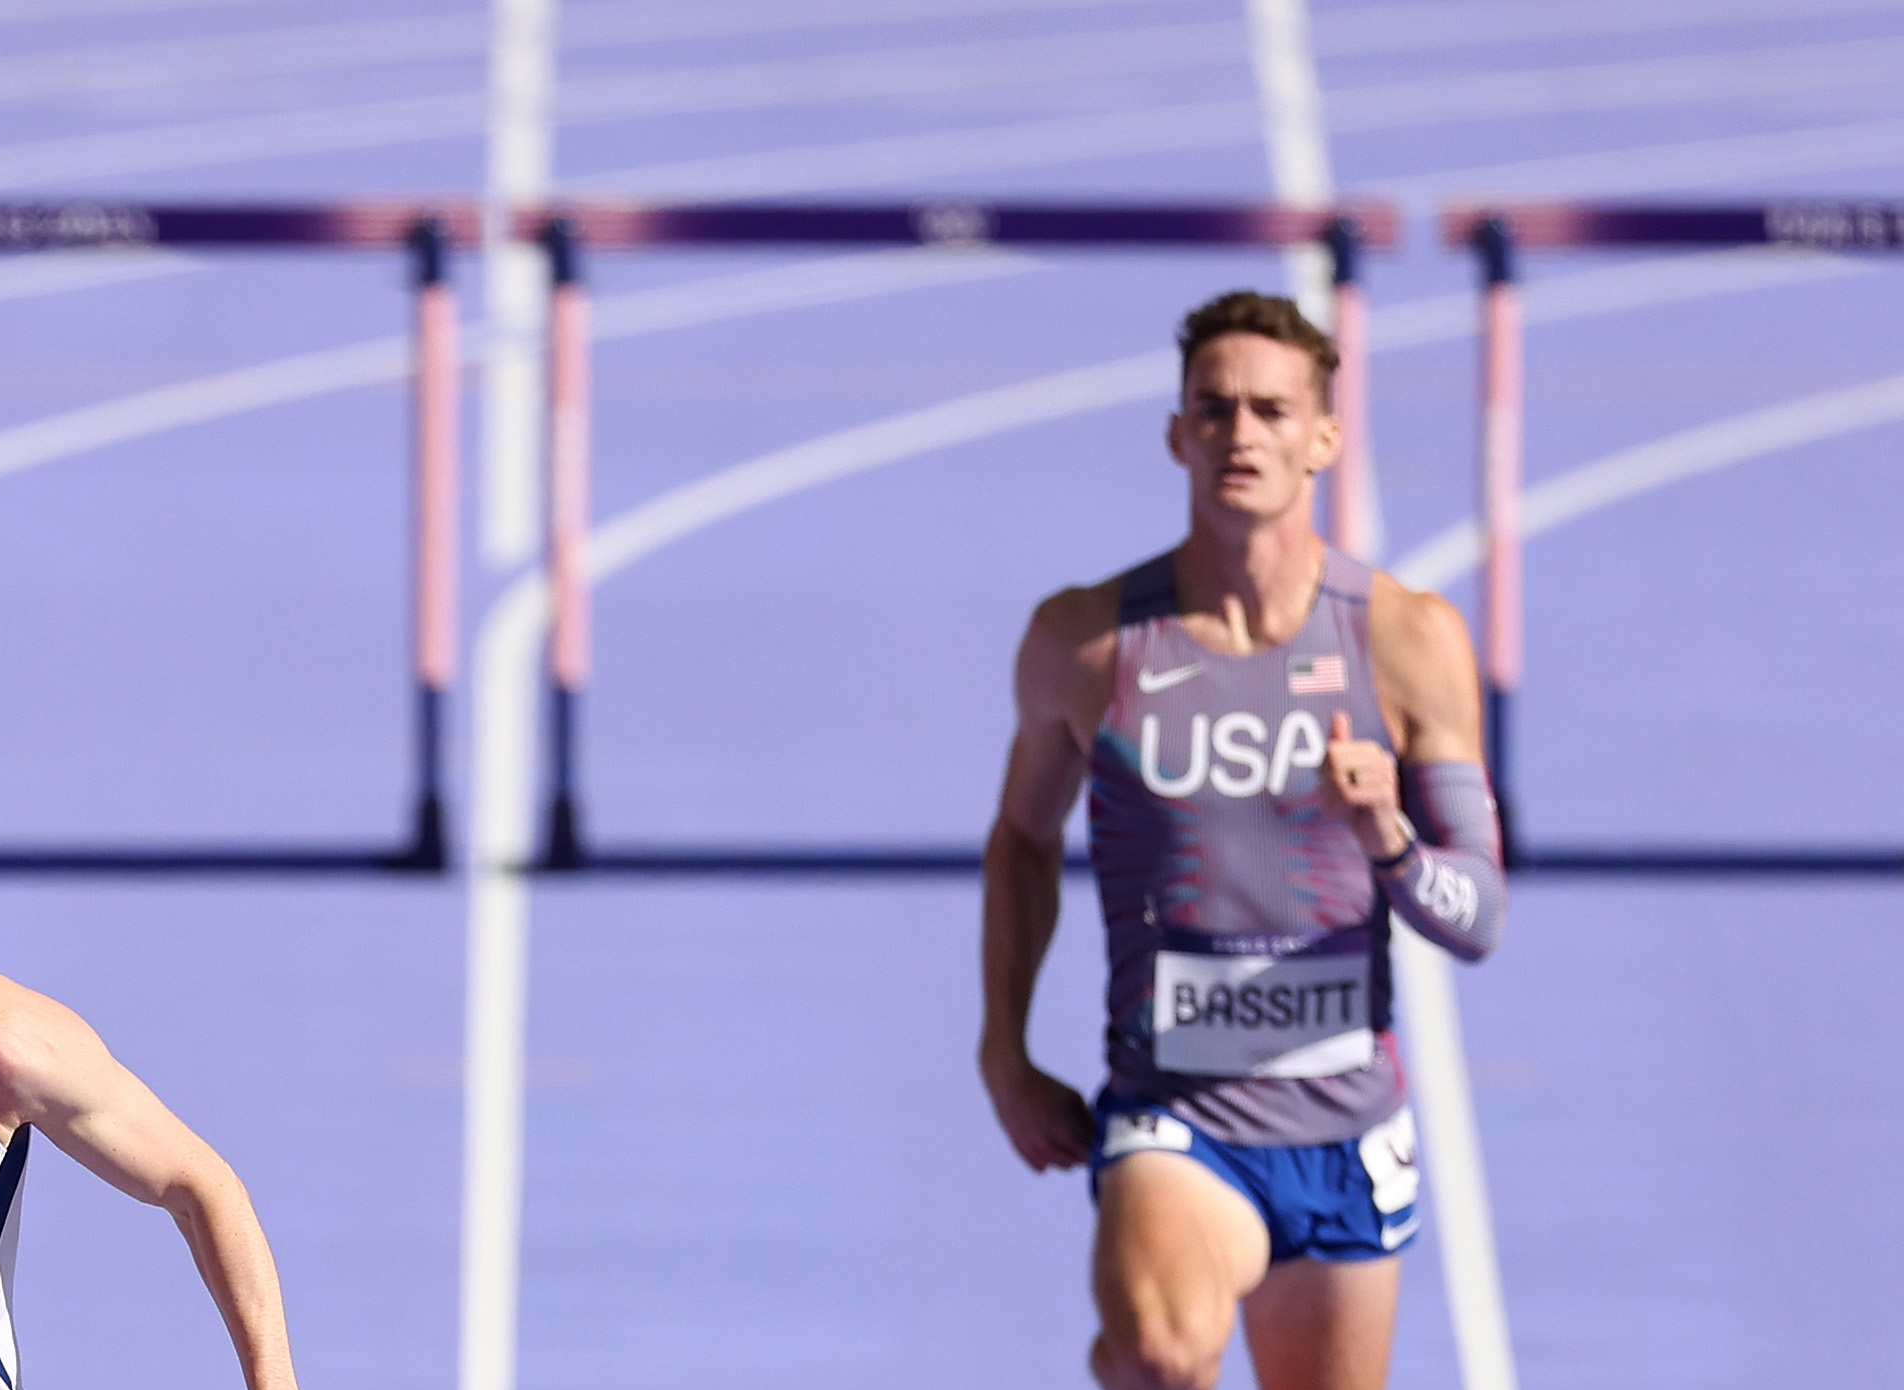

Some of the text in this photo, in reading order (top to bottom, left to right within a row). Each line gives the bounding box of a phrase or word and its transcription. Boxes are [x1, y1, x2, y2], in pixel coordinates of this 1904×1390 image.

[1140, 709, 1327, 799] USA
[1416, 847, 1479, 932] USA
[1174, 980, 1359, 1030] BASSITT
